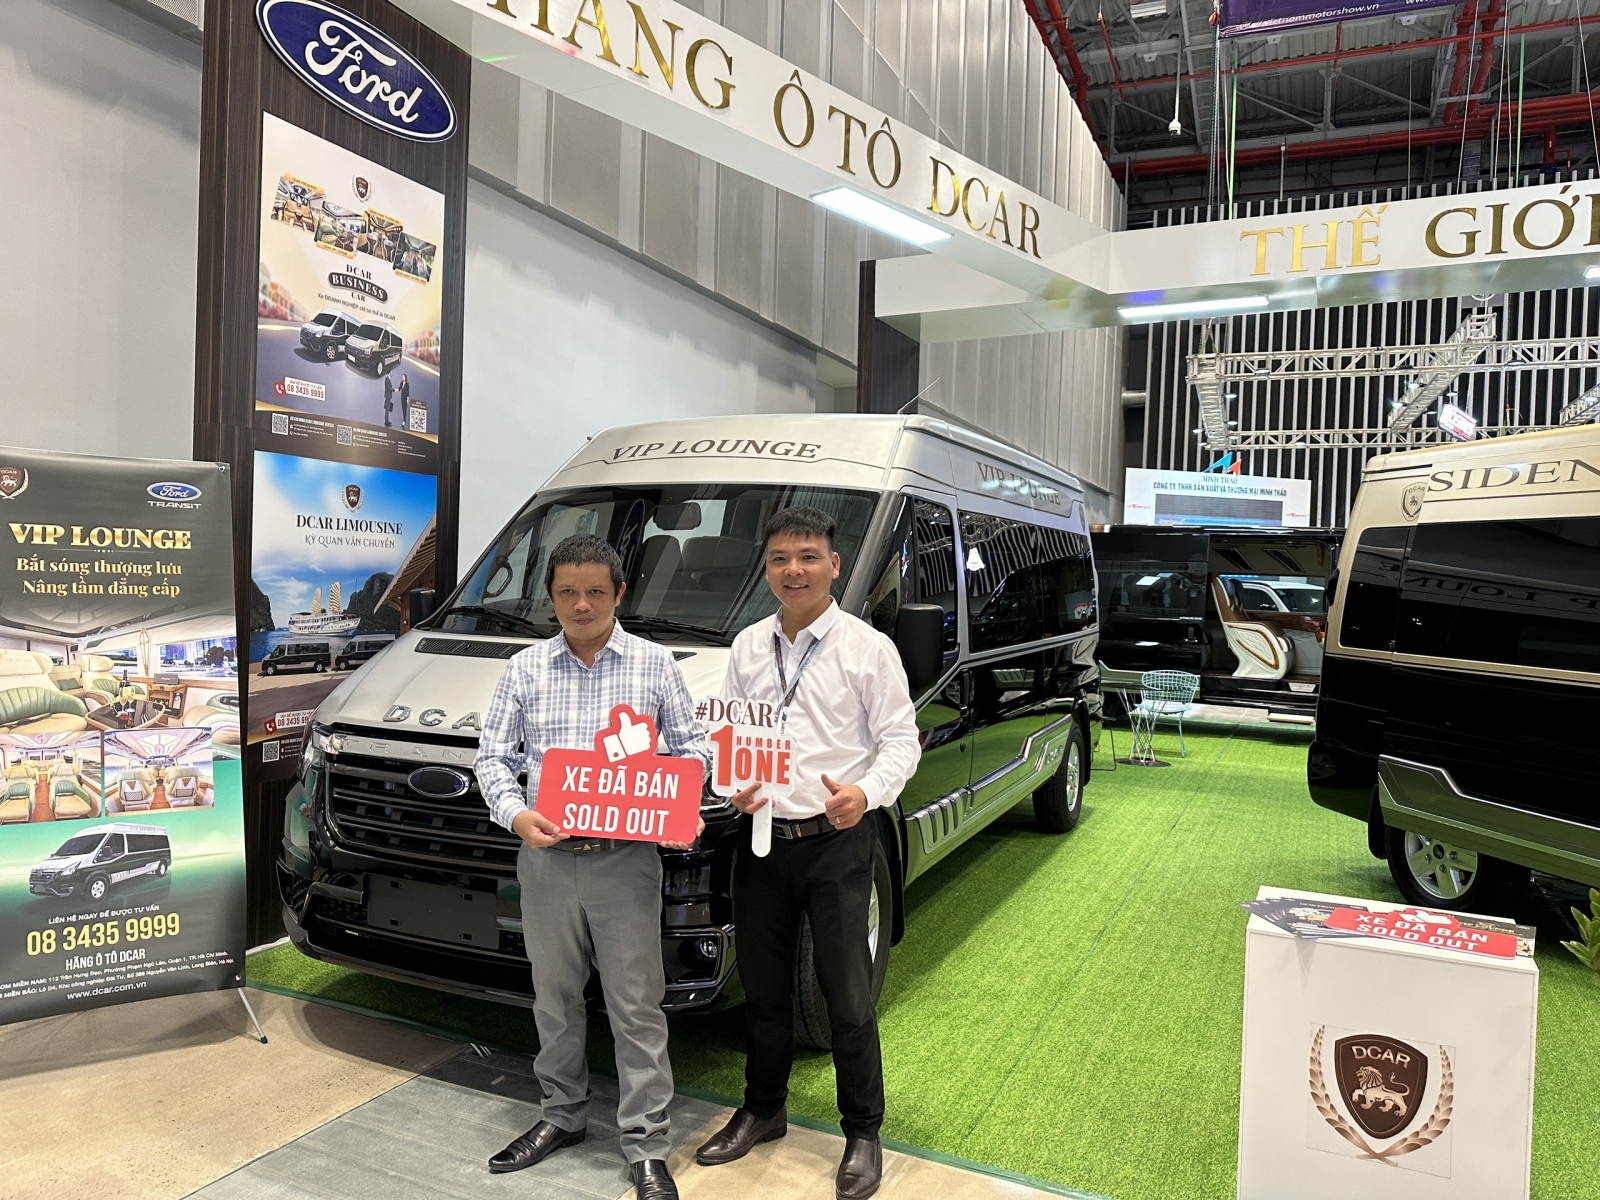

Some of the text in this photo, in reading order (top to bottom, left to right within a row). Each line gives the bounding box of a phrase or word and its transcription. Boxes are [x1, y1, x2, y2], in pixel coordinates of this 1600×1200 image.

[305, 20, 422, 123] Ford
[487, 0, 736, 110] ANG
[927, 156, 1042, 259] DCAR
[1240, 204, 1389, 276] THẾ
[346, 264, 372, 280] DCAR
[331, 274, 384, 299] BUSINESS
[351, 292, 366, 302] CAR
[287, 384, 295, 392] 08
[612, 440, 822, 461] VIP LOUNGE
[976, 461, 1004, 488] VIP
[160, 485, 190, 498] Ford
[147, 501, 201, 509] TRANSIT
[296, 514, 403, 535] DCAR LIMOUSINE
[9, 523, 192, 550] VIP LOUNGE
[318, 536, 343, 548] QUAN
[16, 554, 182, 576] Bắt sóng thượng lưu
[23, 579, 68, 596] Nâng
[72, 576, 103, 594] tầm
[152, 578, 180, 597] cấp
[278, 719, 284, 727] 08
[286, 717, 300, 725] 3435
[383, 704, 482, 731] DCA
[736, 736, 791, 750] NUMBER
[710, 725, 734, 787] 1
[735, 748, 790, 785] ONE
[562, 764, 679, 799] XE ĐÃ BÁN
[563, 803, 670, 836] SOLD OUT
[49, 916, 65, 924] LIÊN
[78, 912, 98, 920] NGAY
[1354, 914, 1387, 926] XE
[27, 912, 180, 956] 08 3435 9999
[1356, 924, 1480, 950] SOLD OUT
[65, 948, 146, 971] HÃNG Ô TÔ DCAR
[67, 980, 147, 1000] www.dcar.com.vn
[1352, 1045, 1410, 1068] DCAR
